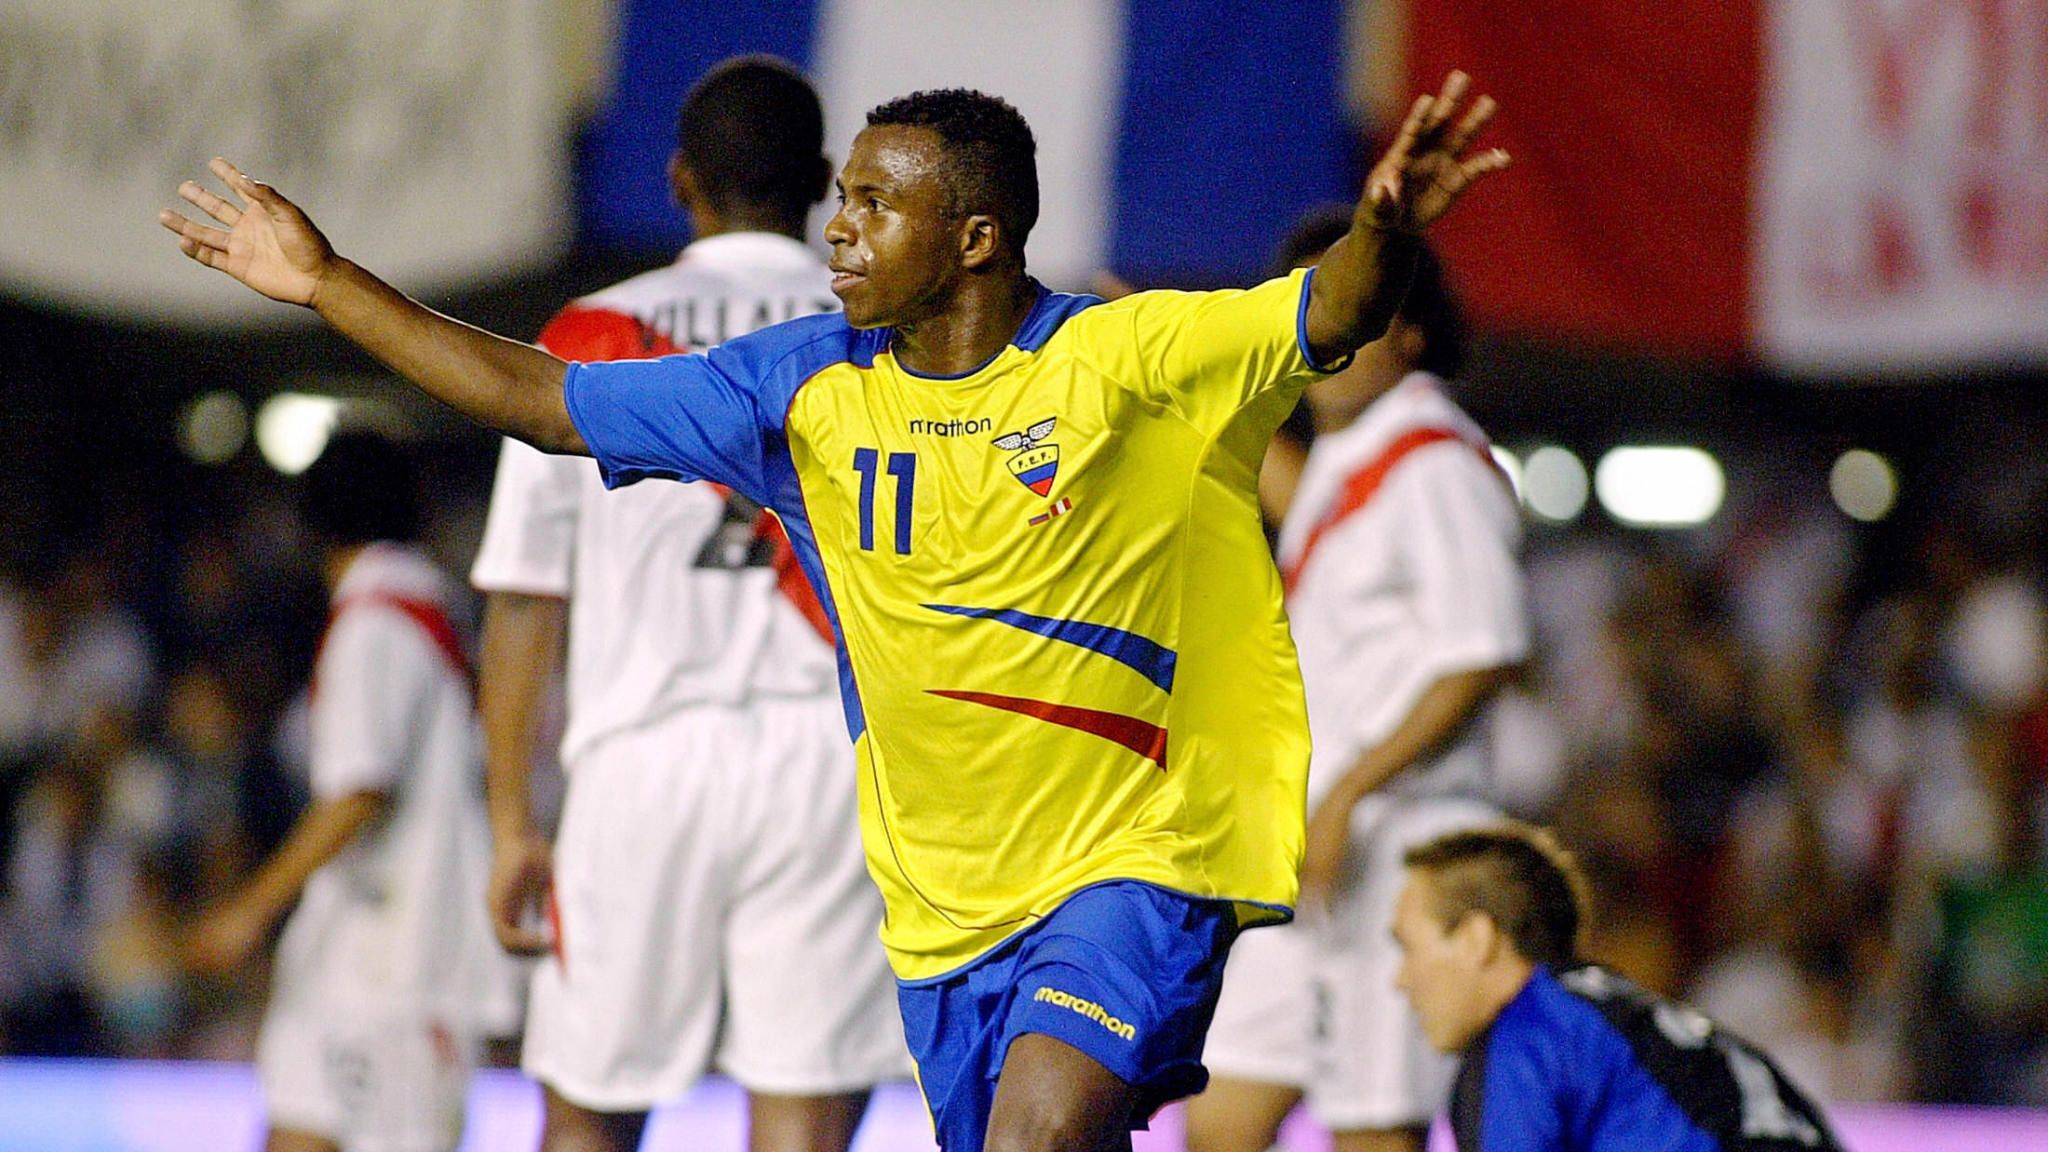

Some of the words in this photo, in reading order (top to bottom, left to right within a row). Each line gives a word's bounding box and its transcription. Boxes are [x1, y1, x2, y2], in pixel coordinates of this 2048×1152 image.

[630, 298, 840, 352] VILLA
[853, 447, 916, 555] 11
[1034, 986, 1136, 1041] marathon
